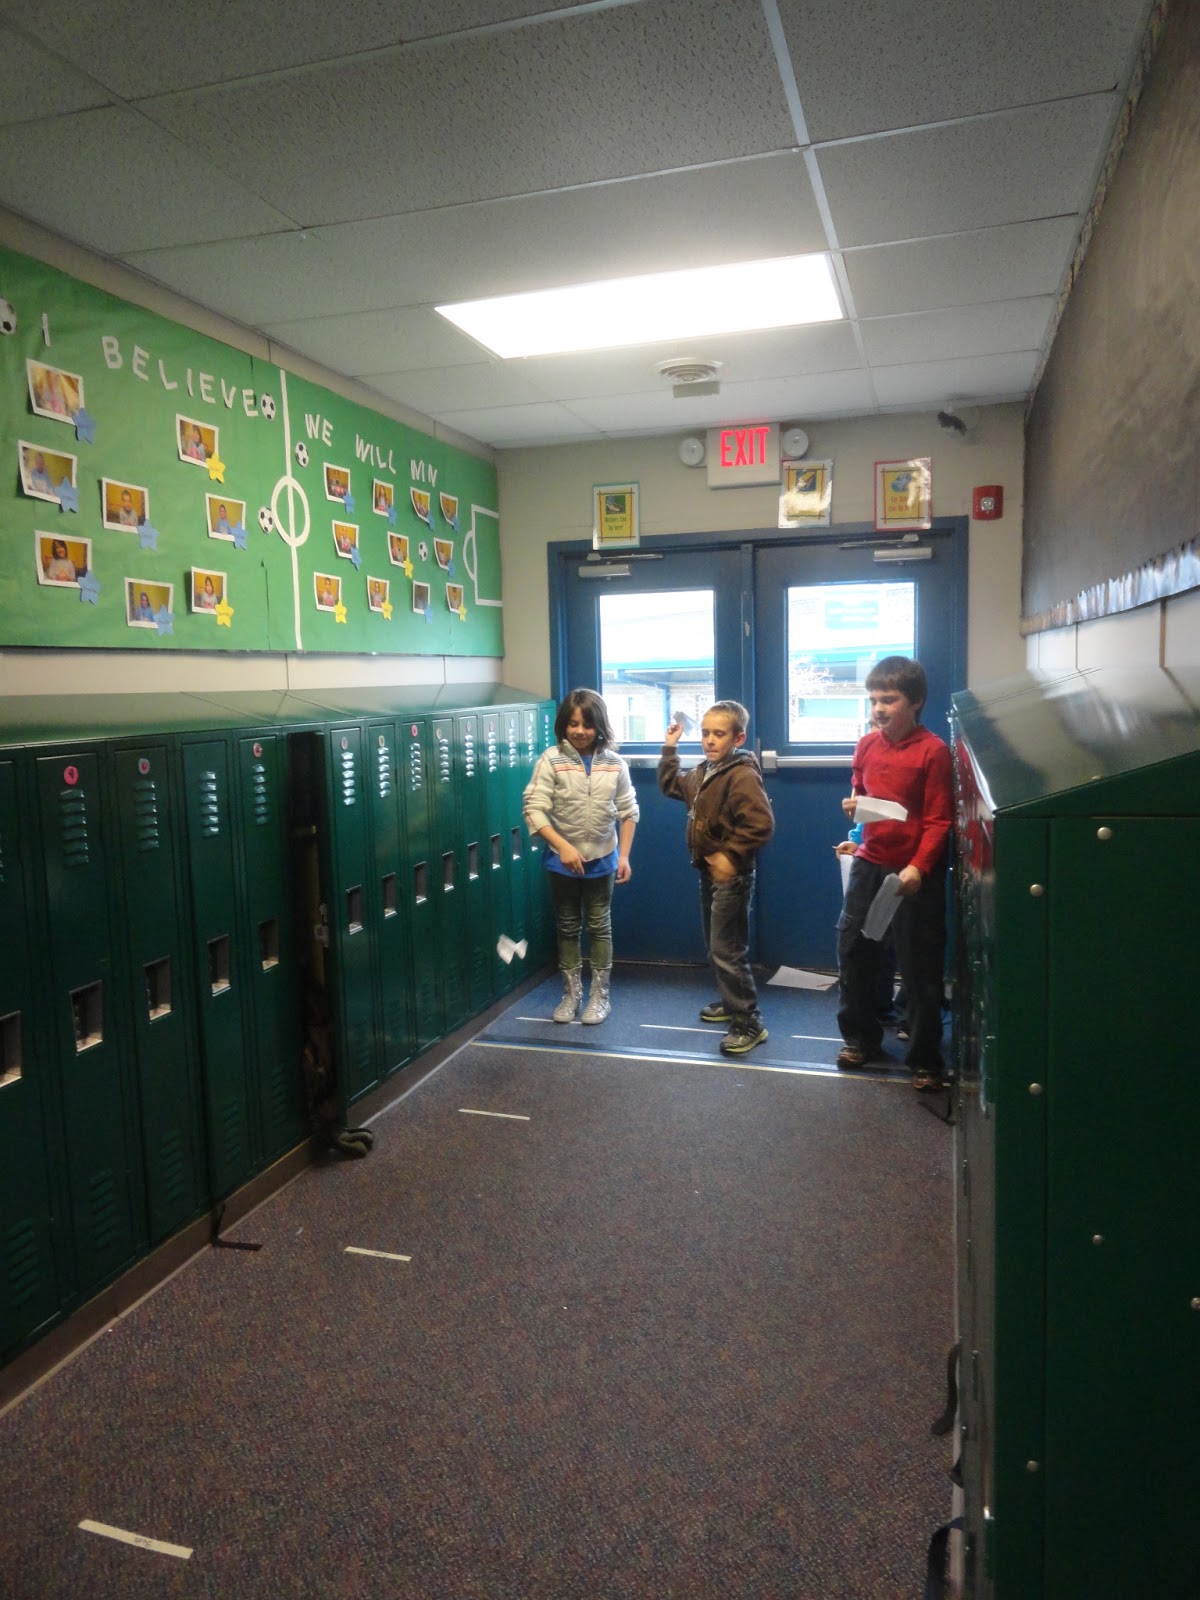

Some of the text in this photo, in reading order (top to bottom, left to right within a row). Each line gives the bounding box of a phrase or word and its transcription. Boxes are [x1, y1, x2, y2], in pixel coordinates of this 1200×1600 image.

[42, 312, 438, 488] I BELIEVE WE WILL WIN
[720, 426, 770, 468] EXIT
